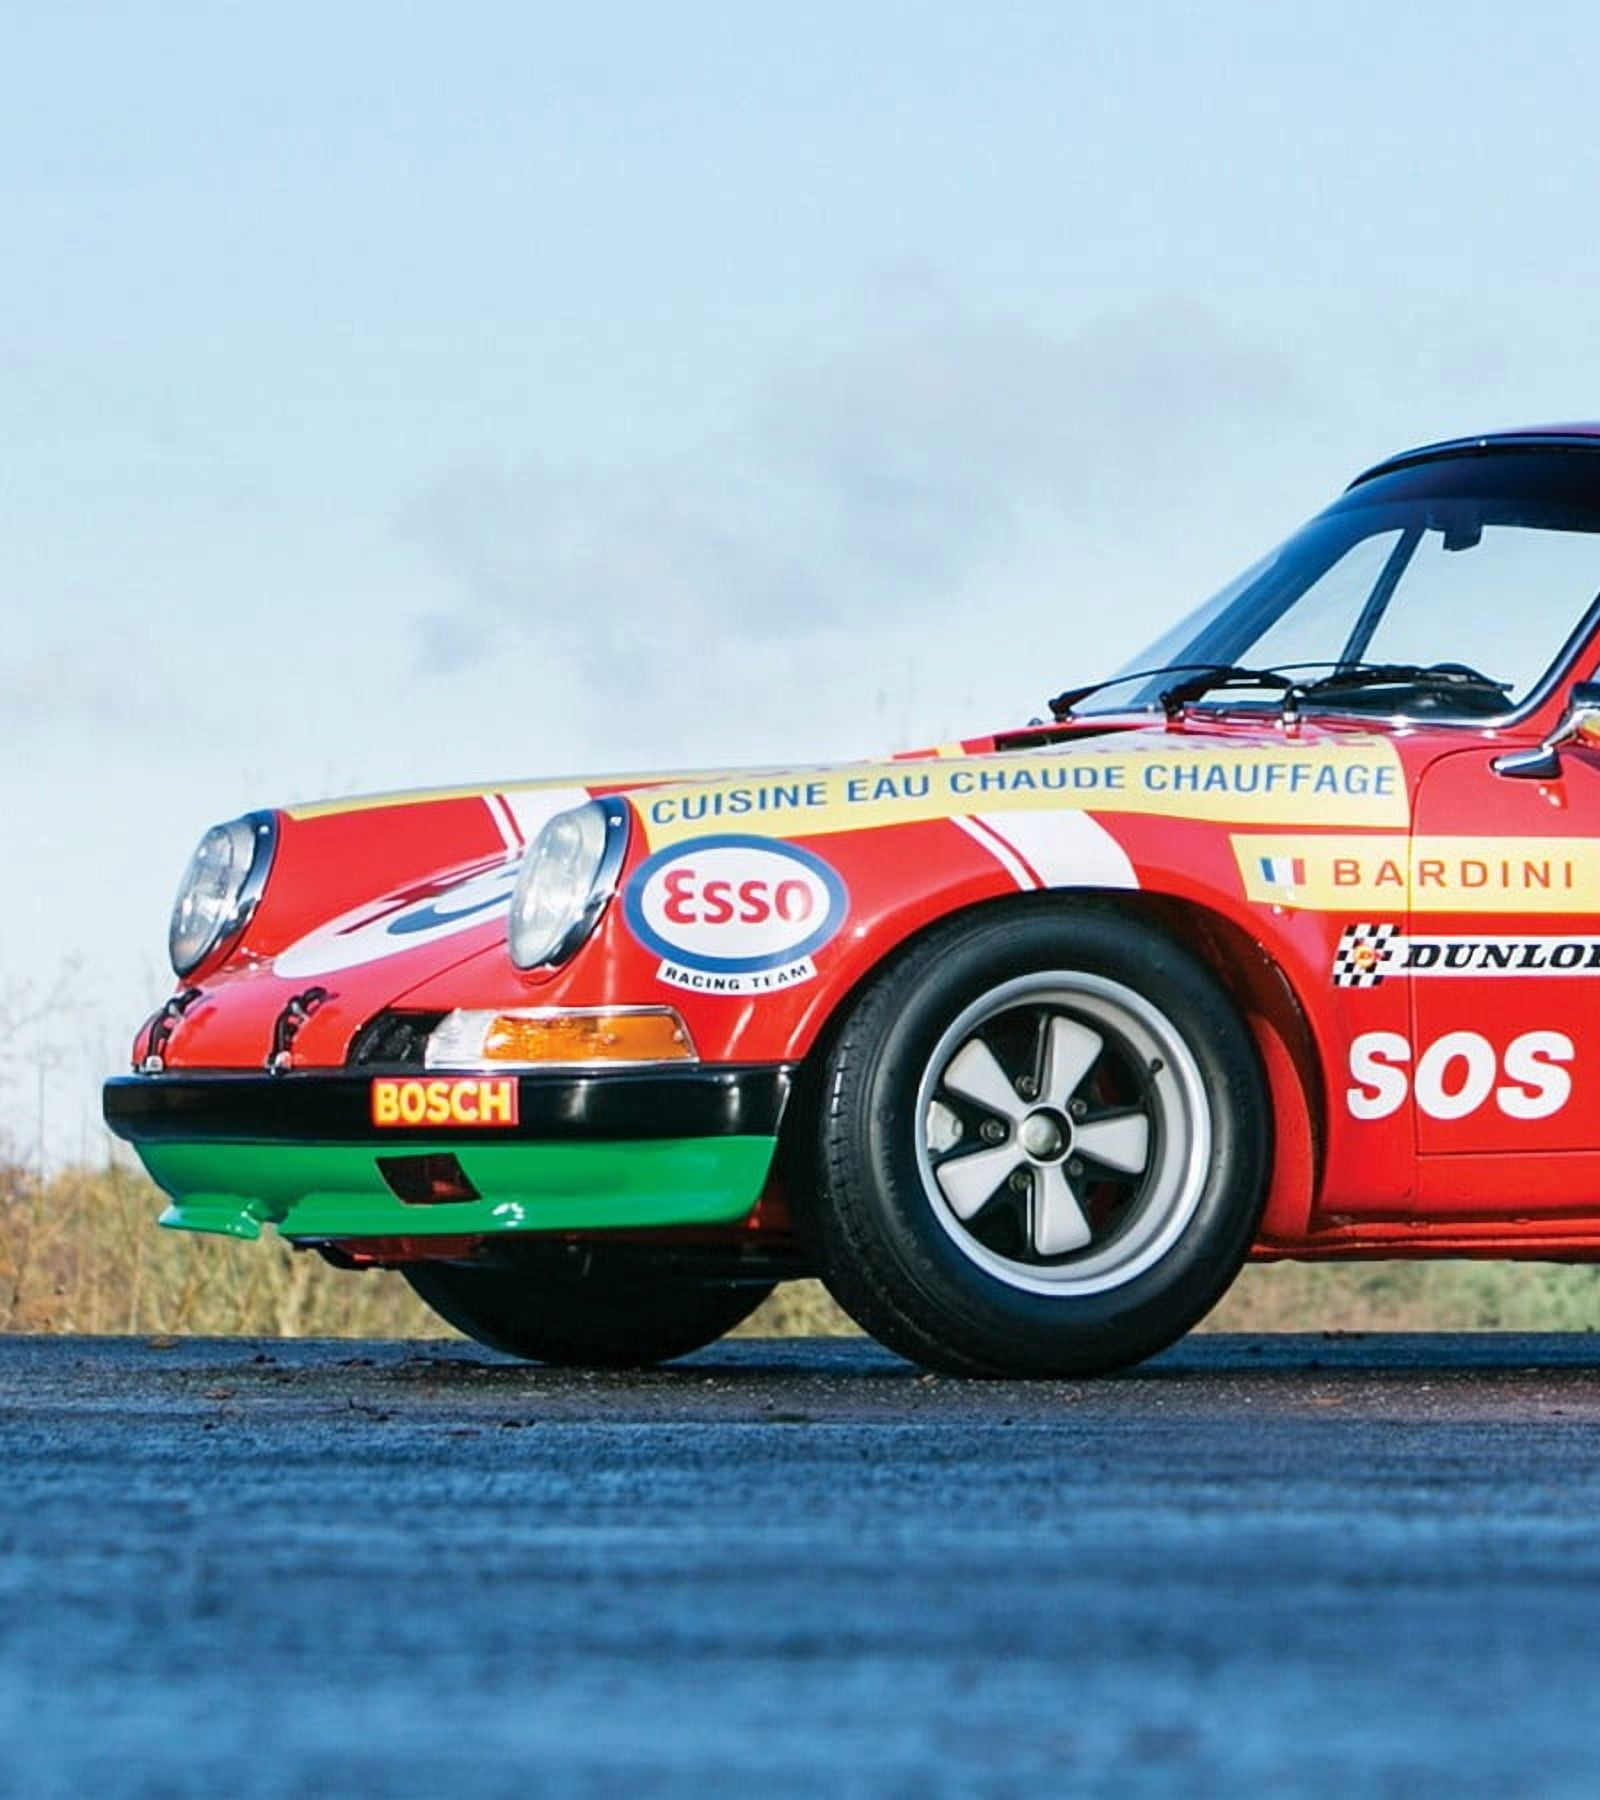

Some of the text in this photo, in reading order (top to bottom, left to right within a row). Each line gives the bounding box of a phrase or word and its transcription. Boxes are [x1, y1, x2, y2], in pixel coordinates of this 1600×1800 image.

[651, 763, 1397, 825] CUISINE EAU CHAUDE CHAUFFAGE
[1333, 859, 1573, 889] BARDINI
[664, 965, 807, 990] RACING TEAM
[1347, 1030, 1576, 1120] SOS
[376, 1081, 511, 1122] BOSCH
